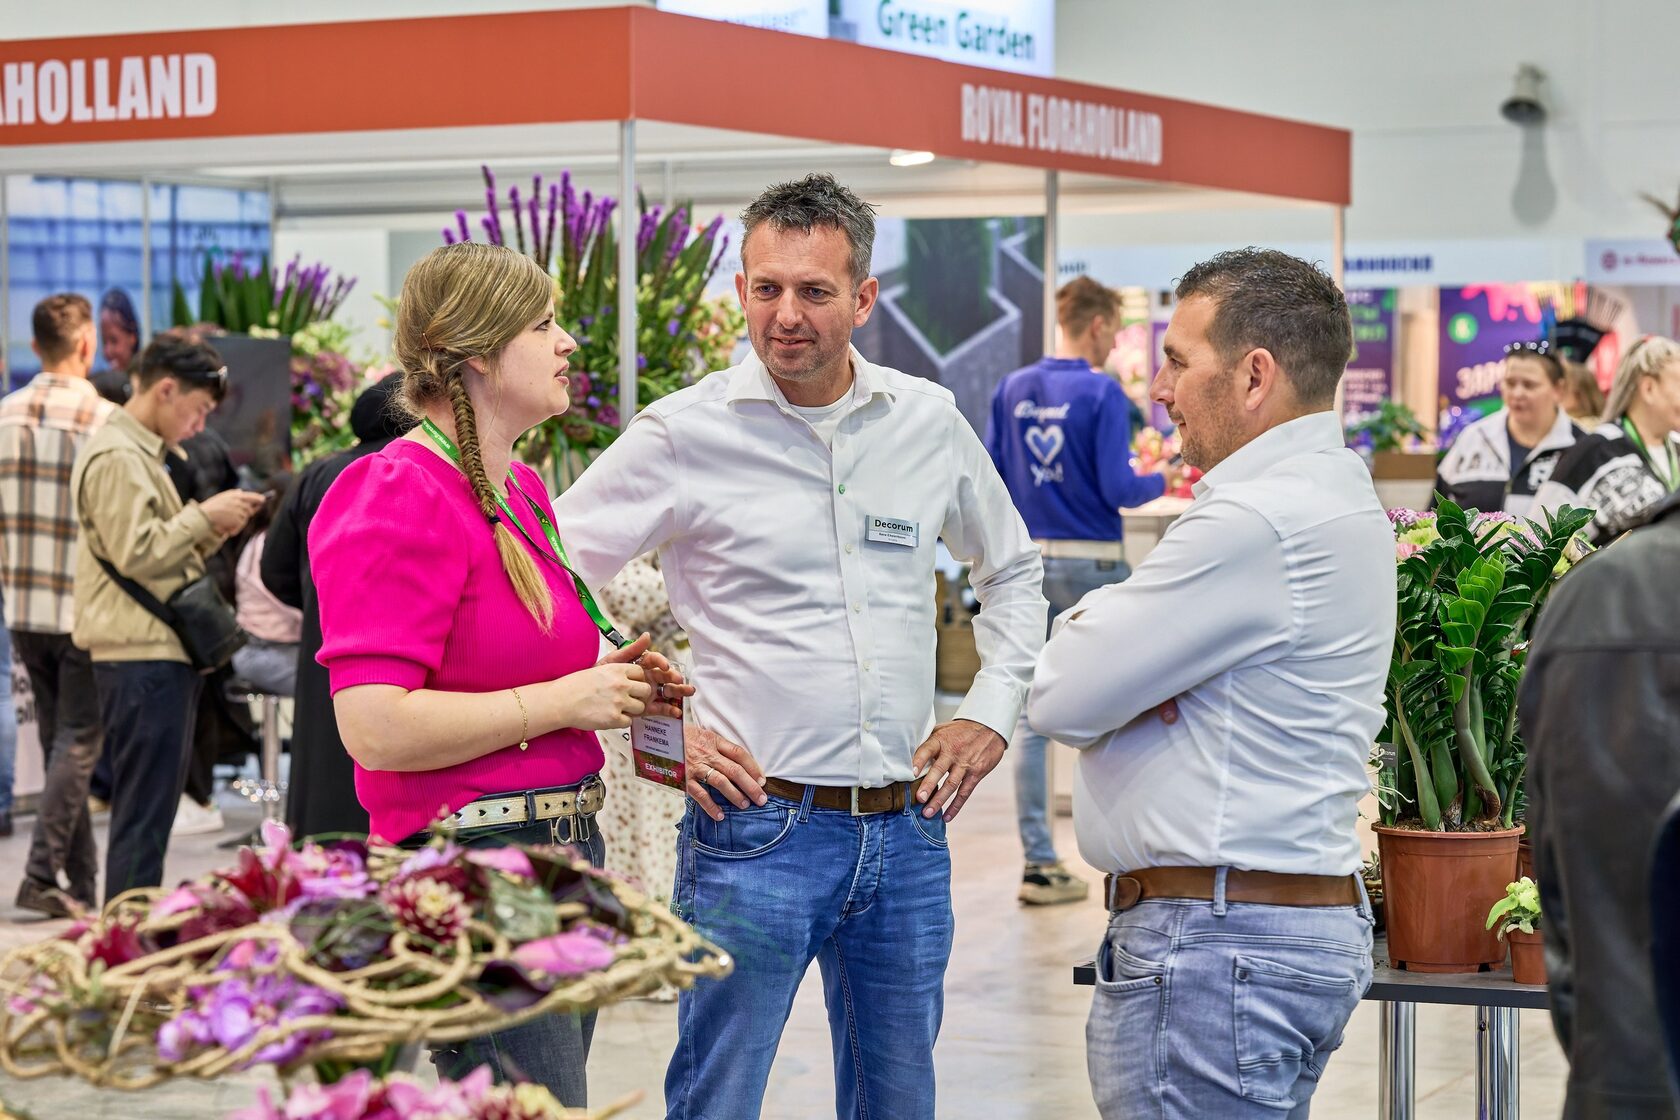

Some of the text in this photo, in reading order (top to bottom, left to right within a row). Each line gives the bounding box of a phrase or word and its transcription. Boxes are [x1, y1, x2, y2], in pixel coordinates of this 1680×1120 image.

[877, 0, 1036, 61] Green Garden
[0, 53, 217, 126] HOLLAND
[961, 83, 1163, 166] ROYAL FLORAHOLLAND
[874, 519, 914, 533] Decorum
[644, 724, 667, 737] HANNEKE
[643, 733, 670, 747] FRANKEMA
[644, 762, 678, 779] EXHIBITOR
